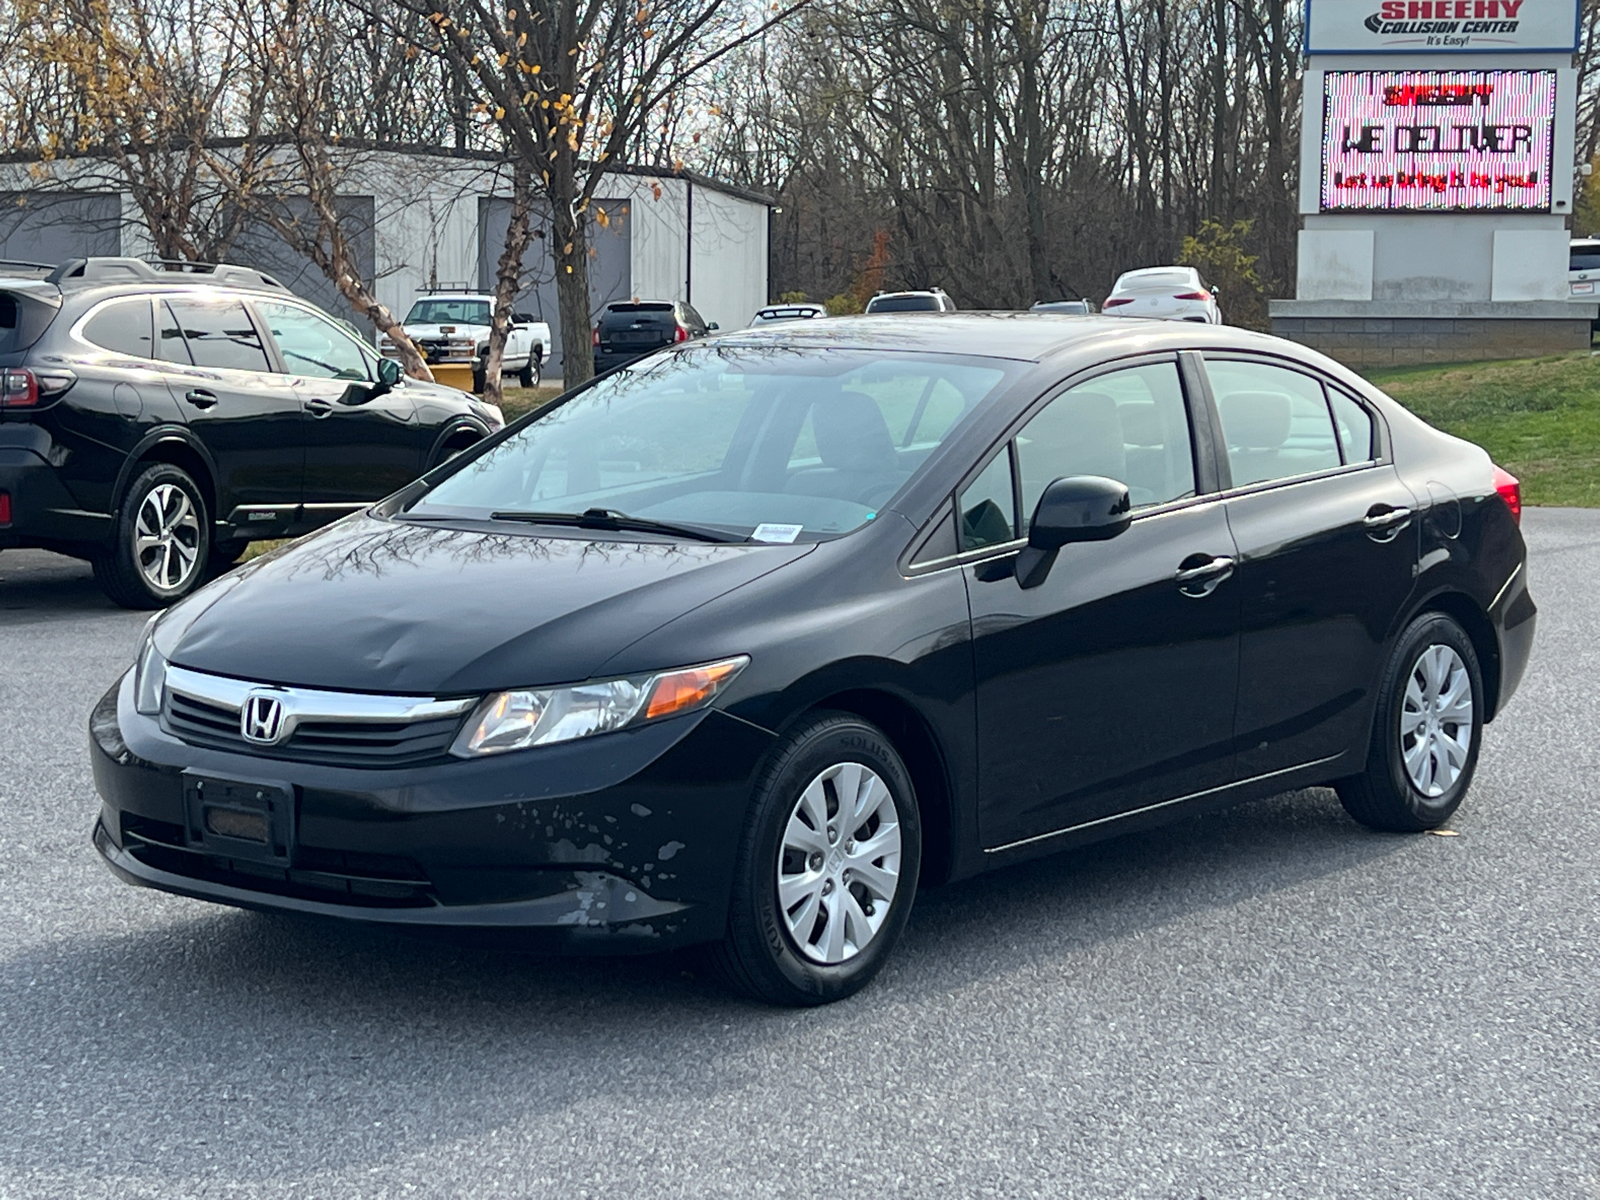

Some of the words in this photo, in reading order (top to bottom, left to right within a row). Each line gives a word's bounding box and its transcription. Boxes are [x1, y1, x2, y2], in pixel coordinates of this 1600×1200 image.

[1381, 0, 1523, 19] SHEEHY
[1380, 21, 1460, 34] COLLISION
[1461, 21, 1520, 33] CENTER
[1426, 35, 1441, 46] It's
[1443, 35, 1470, 47] Easy!
[1394, 124, 1532, 154] DELIVER
